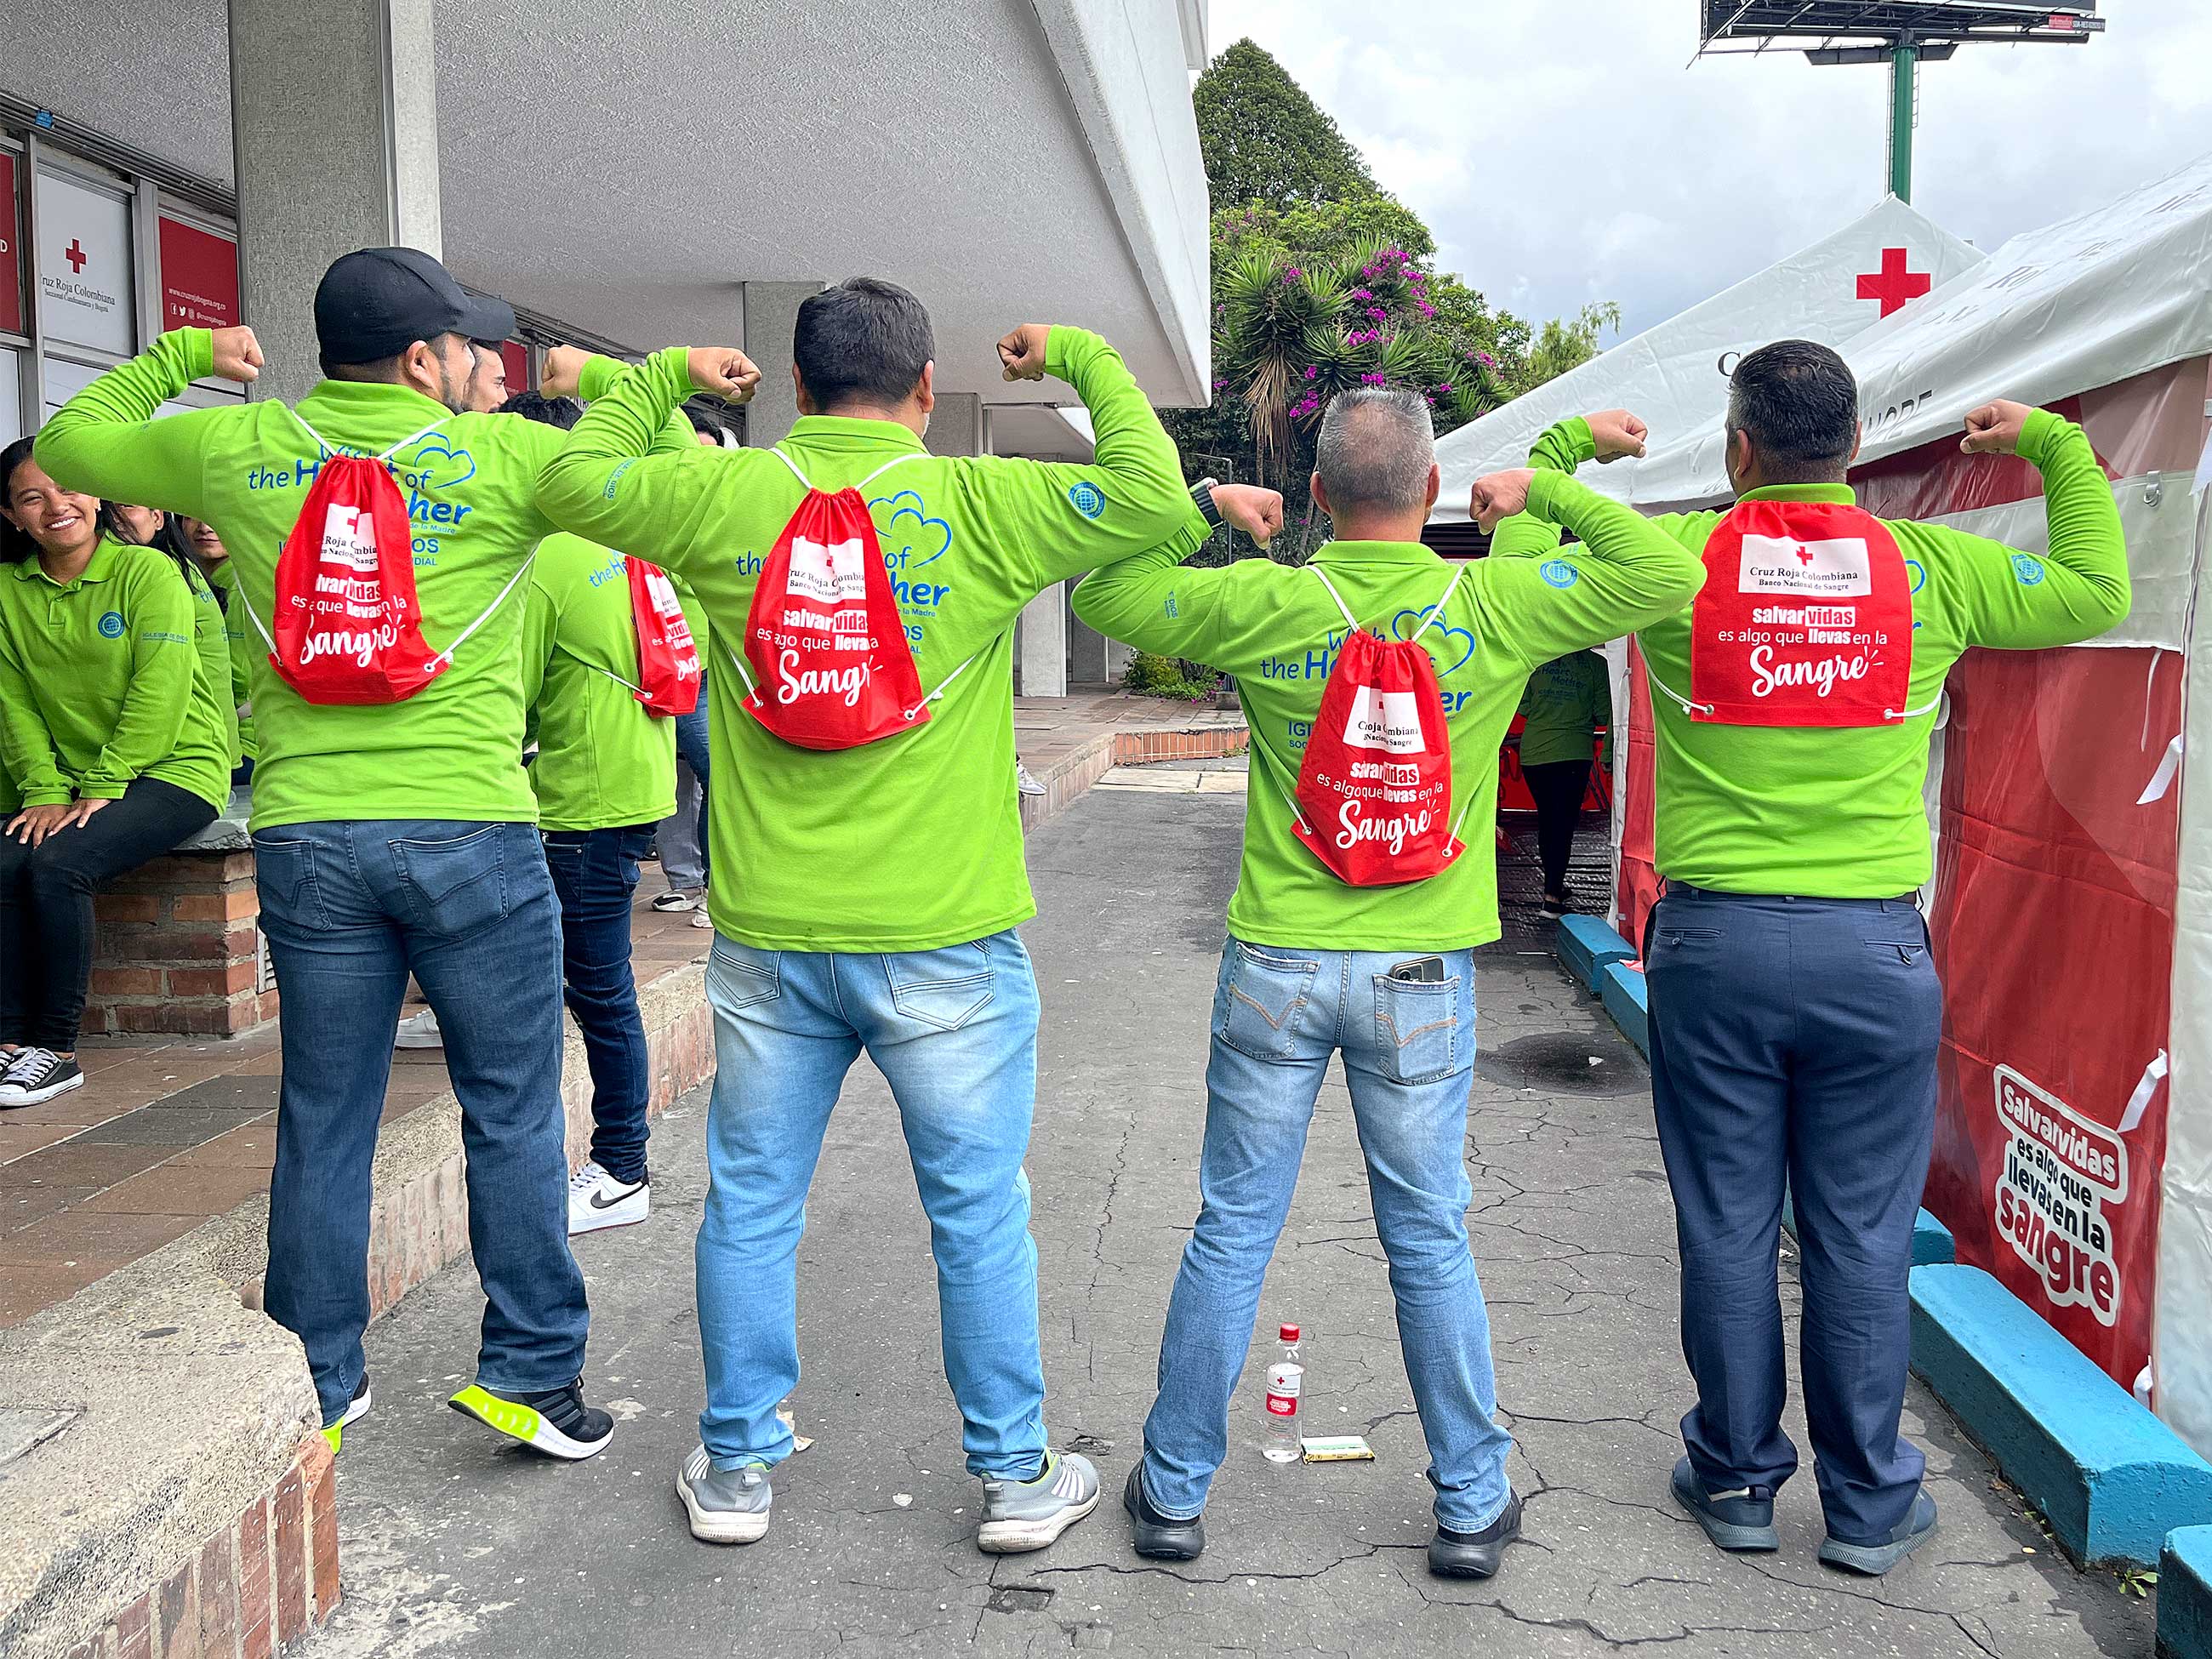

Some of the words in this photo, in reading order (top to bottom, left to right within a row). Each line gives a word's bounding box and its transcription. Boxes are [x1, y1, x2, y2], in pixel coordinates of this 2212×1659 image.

[41, 277, 54, 287] ruz
[55, 277, 72, 294] Roja
[74, 283, 116, 305] Colombiana
[248, 465, 289, 489] the
[405, 470, 435, 490] of
[408, 490, 473, 525] her
[325, 535, 346, 548] Roja
[885, 546, 912, 569] of
[589, 569, 613, 587] the
[789, 569, 806, 579] ruz
[808, 573, 829, 588] Roja
[790, 579, 812, 590] Banco
[1749, 567, 1775, 577] Cruz
[1777, 567, 1800, 579] Roja
[1801, 570, 1858, 582] Colombiana
[1783, 580, 1813, 590] Nacional
[890, 571, 950, 607] her
[291, 595, 308, 607] es
[316, 600, 344, 615] que
[393, 595, 408, 609] la
[911, 608, 936, 618] Madre
[756, 627, 772, 641] es
[801, 637, 831, 653] que
[835, 635, 869, 651] lleva
[1718, 630, 1735, 642] es
[1738, 628, 1771, 647] algo
[1775, 635, 1804, 647] que
[1807, 628, 1851, 644] llevas
[1852, 633, 1871, 645] en
[1875, 630, 1889, 645] la
[778, 648, 870, 707] Sangr
[1260, 657, 1300, 680] the
[1749, 645, 1869, 698] Sangre
[1316, 772, 1331, 787] es
[1333, 779, 1361, 800] algo
[1362, 785, 1383, 801] que
[1418, 788, 1433, 801] en
[1434, 781, 1444, 794] la
[1335, 799, 1432, 856] Sangre
[2016, 1137, 2033, 1162] es
[2036, 1149, 2059, 1185] algo
[2060, 1172, 2093, 1208] que
[2008, 1152, 2052, 1215] llevas
[2052, 1197, 2078, 1238] en
[2082, 1210, 2106, 1253] la
[1999, 1186, 2115, 1314] sangre
